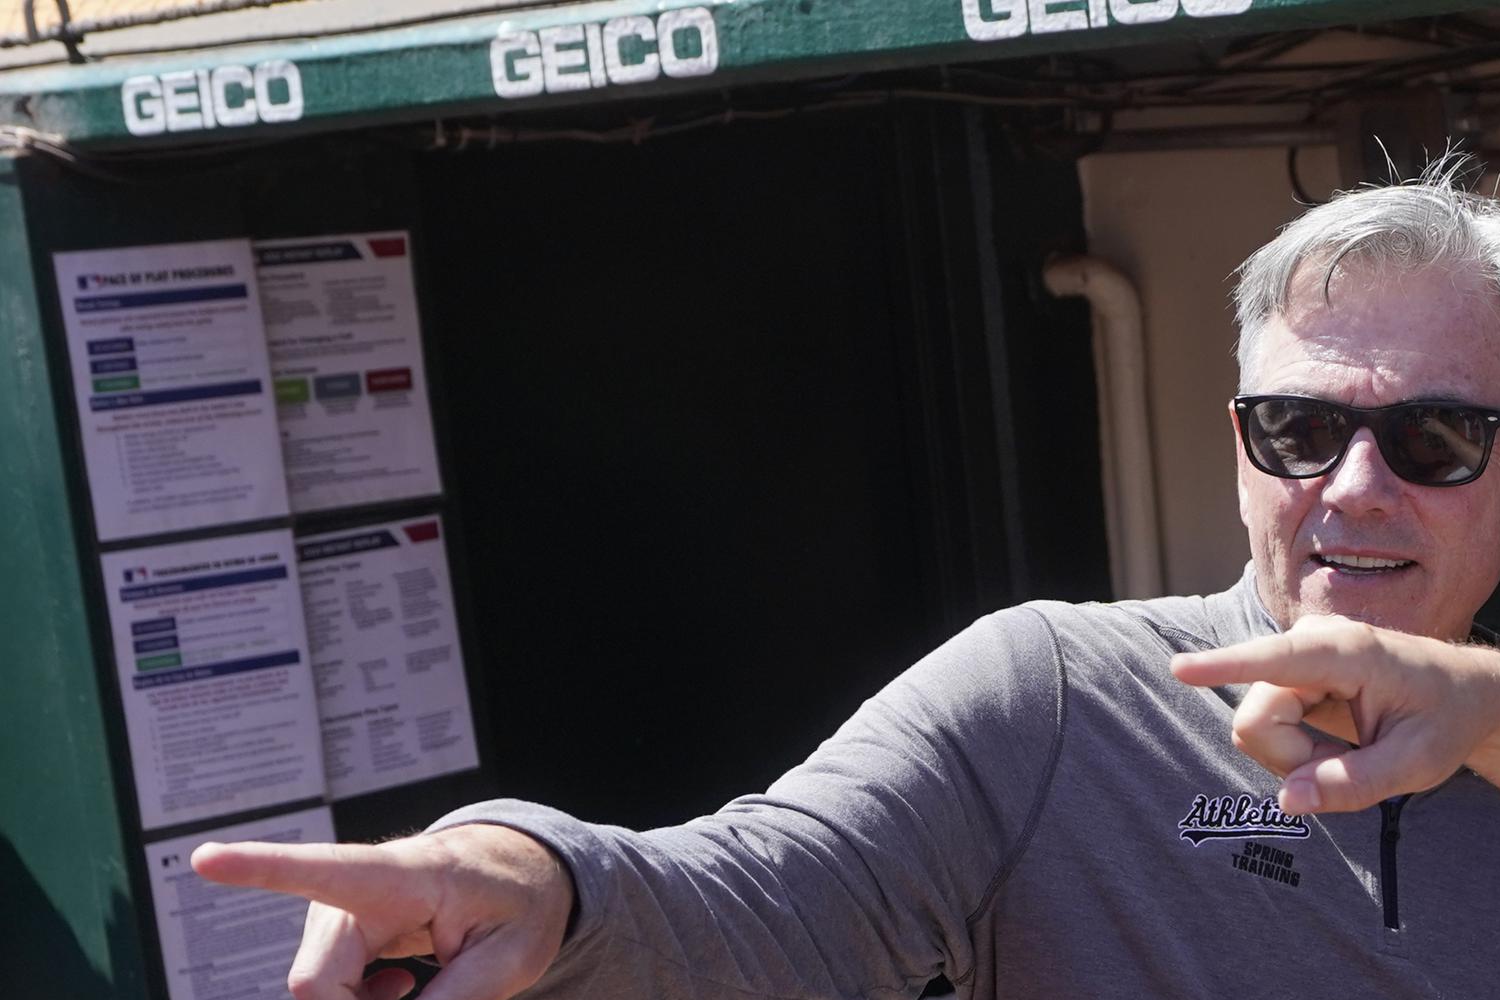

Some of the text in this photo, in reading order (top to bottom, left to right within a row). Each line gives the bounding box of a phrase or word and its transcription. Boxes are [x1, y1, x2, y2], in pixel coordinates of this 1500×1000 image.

[489, 7, 719, 99] GEICO
[122, 60, 303, 136] GEICO
[1231, 853, 1301, 888] TRAINING
[1243, 841, 1295, 869] SPRING
